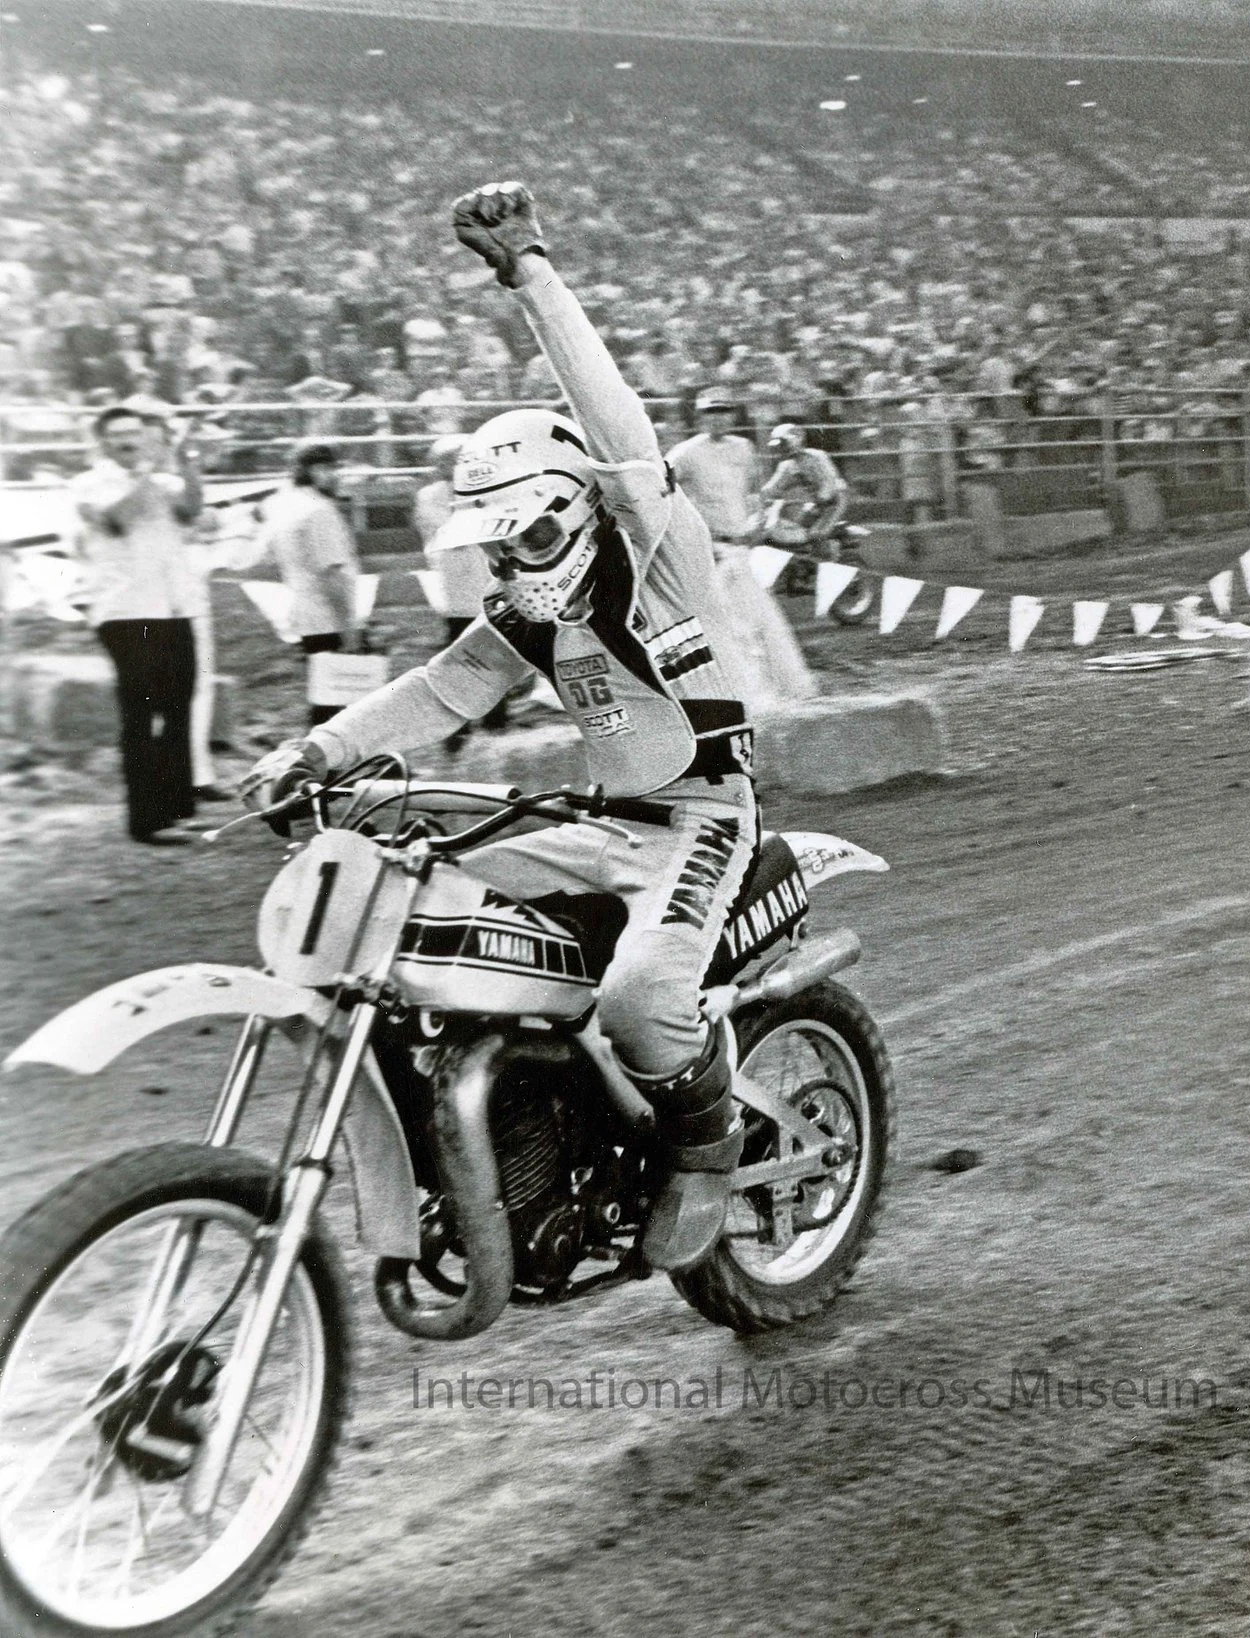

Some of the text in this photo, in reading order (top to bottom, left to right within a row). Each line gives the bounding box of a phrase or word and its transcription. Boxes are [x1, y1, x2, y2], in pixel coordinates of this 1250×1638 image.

[299, 860, 341, 956] 1
[660, 816, 741, 932] YAMAHA
[722, 870, 809, 960] YAMAHA
[477, 929, 536, 967] YAMAHA
